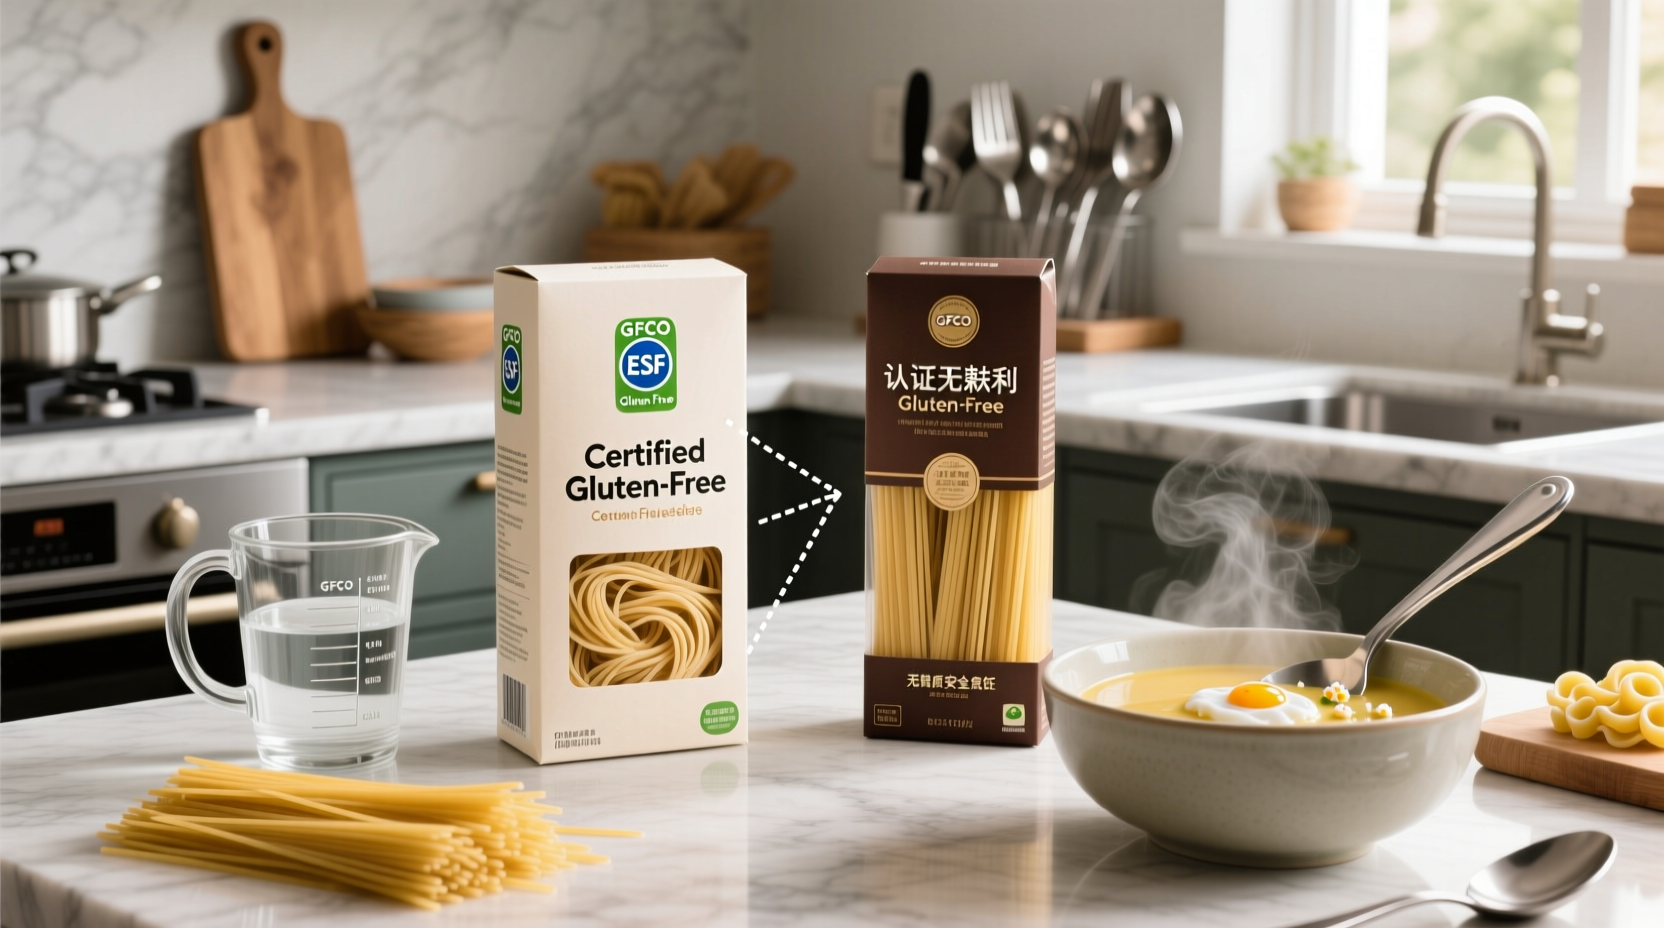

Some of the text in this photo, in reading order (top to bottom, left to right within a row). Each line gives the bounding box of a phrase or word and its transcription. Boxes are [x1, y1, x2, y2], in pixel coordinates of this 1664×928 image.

[620, 320, 671, 337] GFCO
[627, 354, 666, 376] ESF
[898, 394, 1004, 414] Gluten-Free
[584, 437, 705, 469] Certified
[565, 471, 727, 501] Gluten-Free
[320, 580, 353, 592] GFCO
